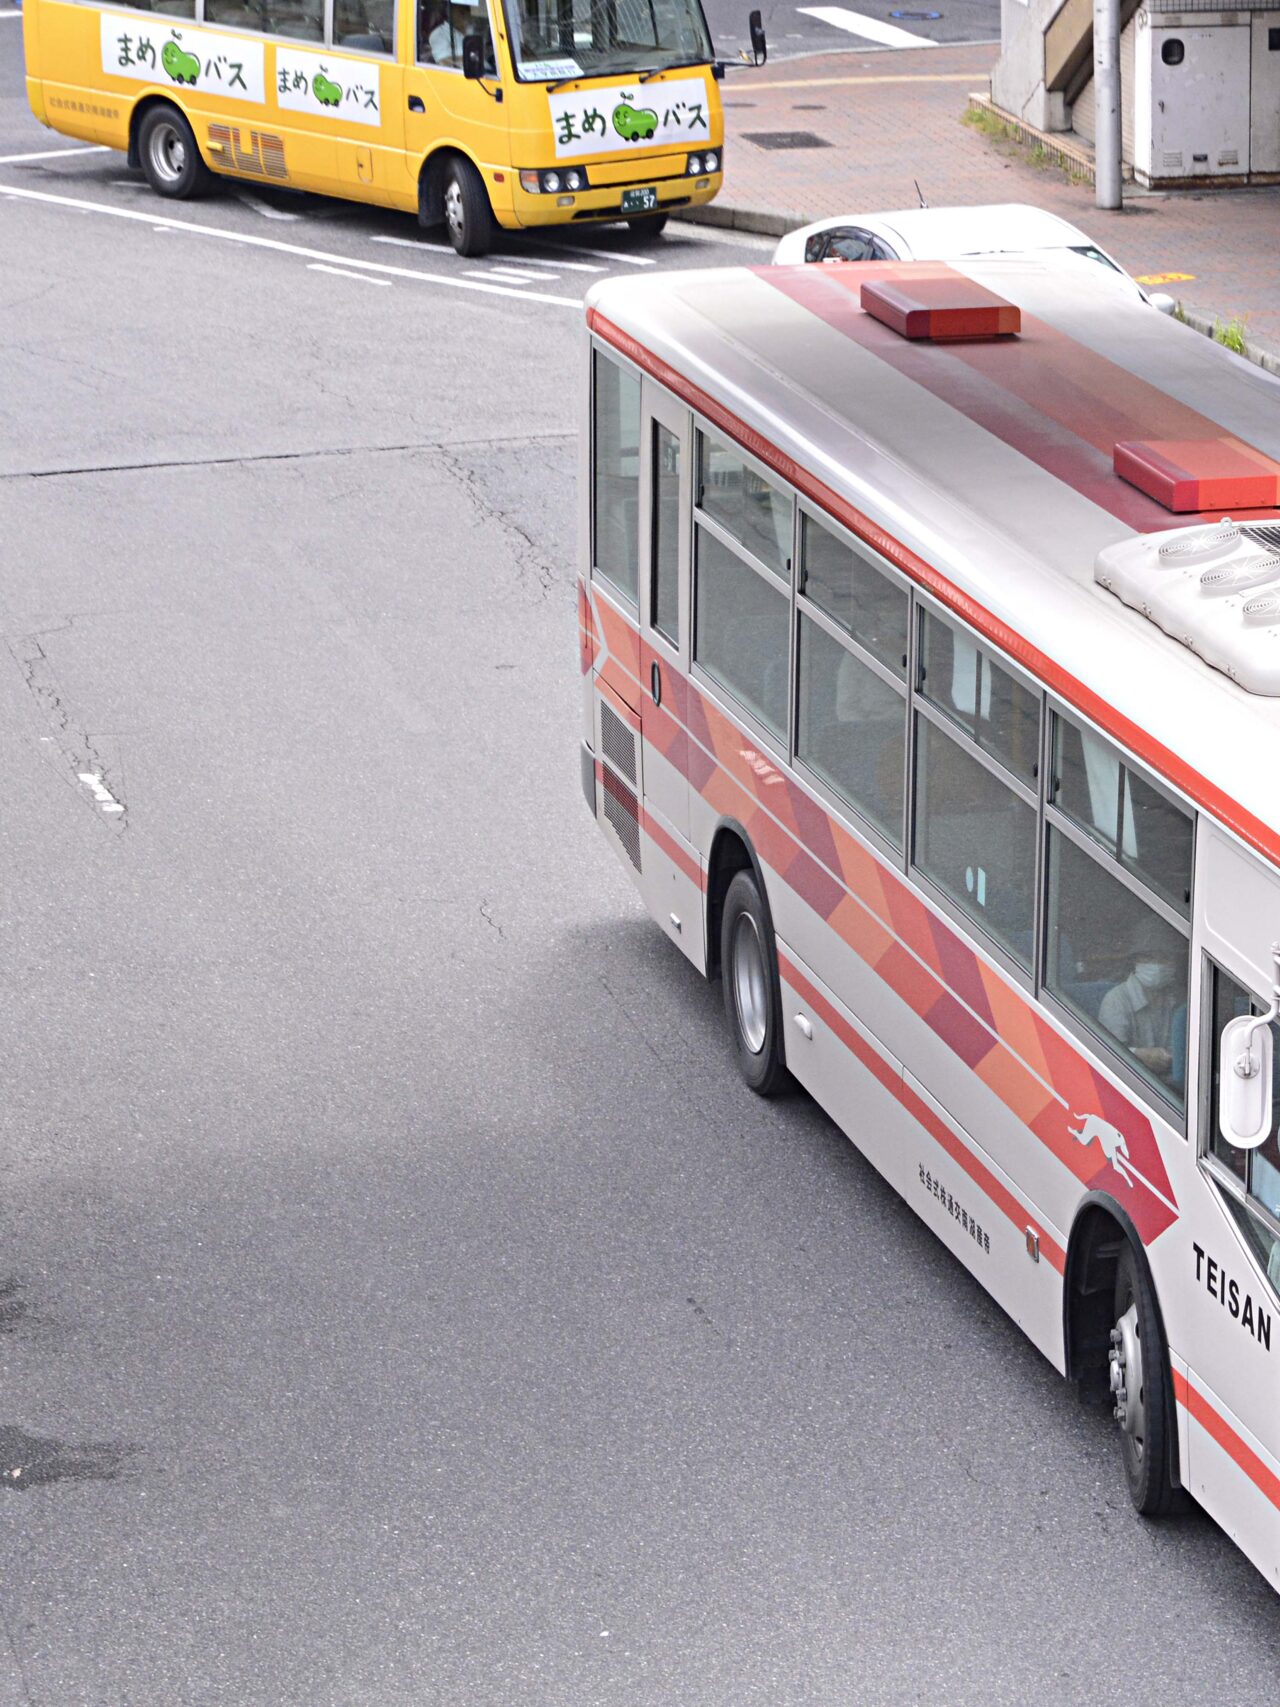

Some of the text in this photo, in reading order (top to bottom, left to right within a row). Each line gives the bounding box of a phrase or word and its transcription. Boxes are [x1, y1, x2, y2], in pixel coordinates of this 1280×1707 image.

[117, 33, 248, 91] まめ バス
[277, 68, 379, 110] まめ バス
[556, 102, 708, 145] まめ バス
[1192, 1242, 1272, 1353] TEISAN
